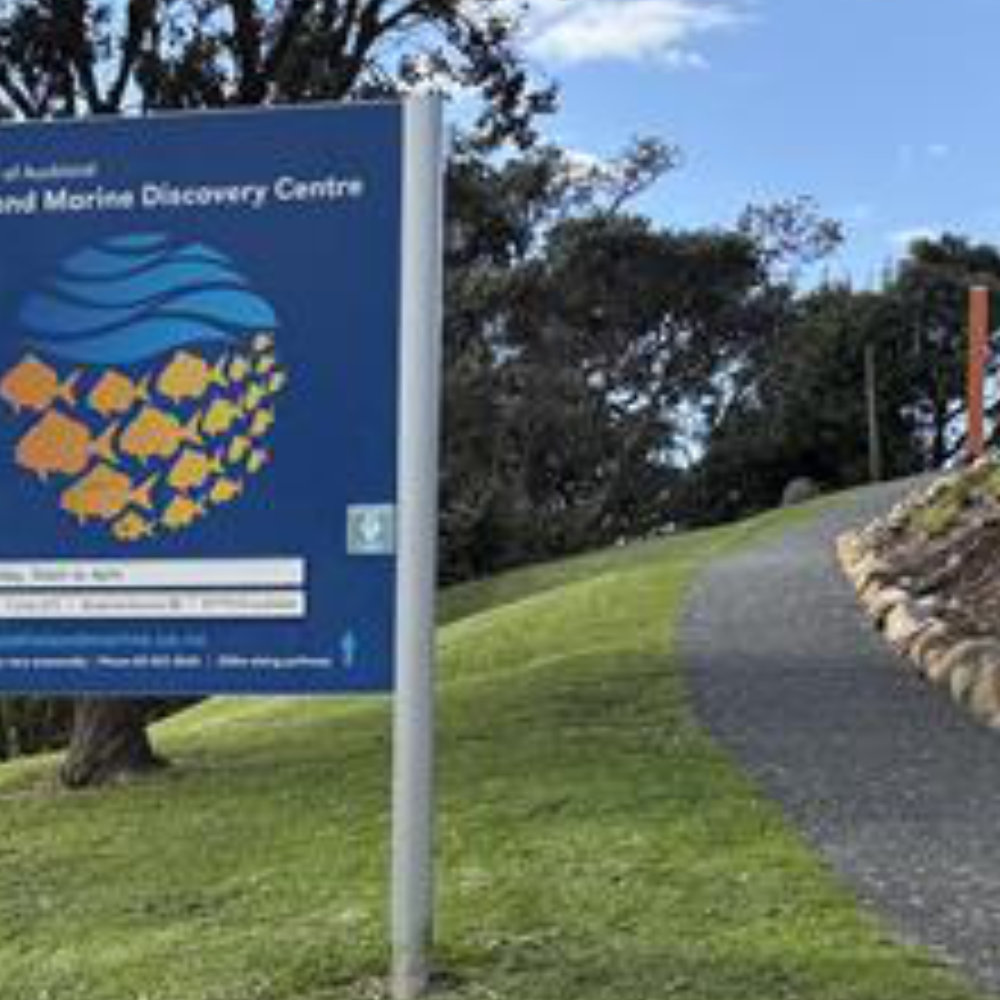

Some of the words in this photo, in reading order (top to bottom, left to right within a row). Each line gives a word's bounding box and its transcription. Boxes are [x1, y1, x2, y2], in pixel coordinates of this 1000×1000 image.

[41, 186, 134, 212] Marine
[141, 180, 269, 209] Discovery
[274, 175, 364, 201] Centre
